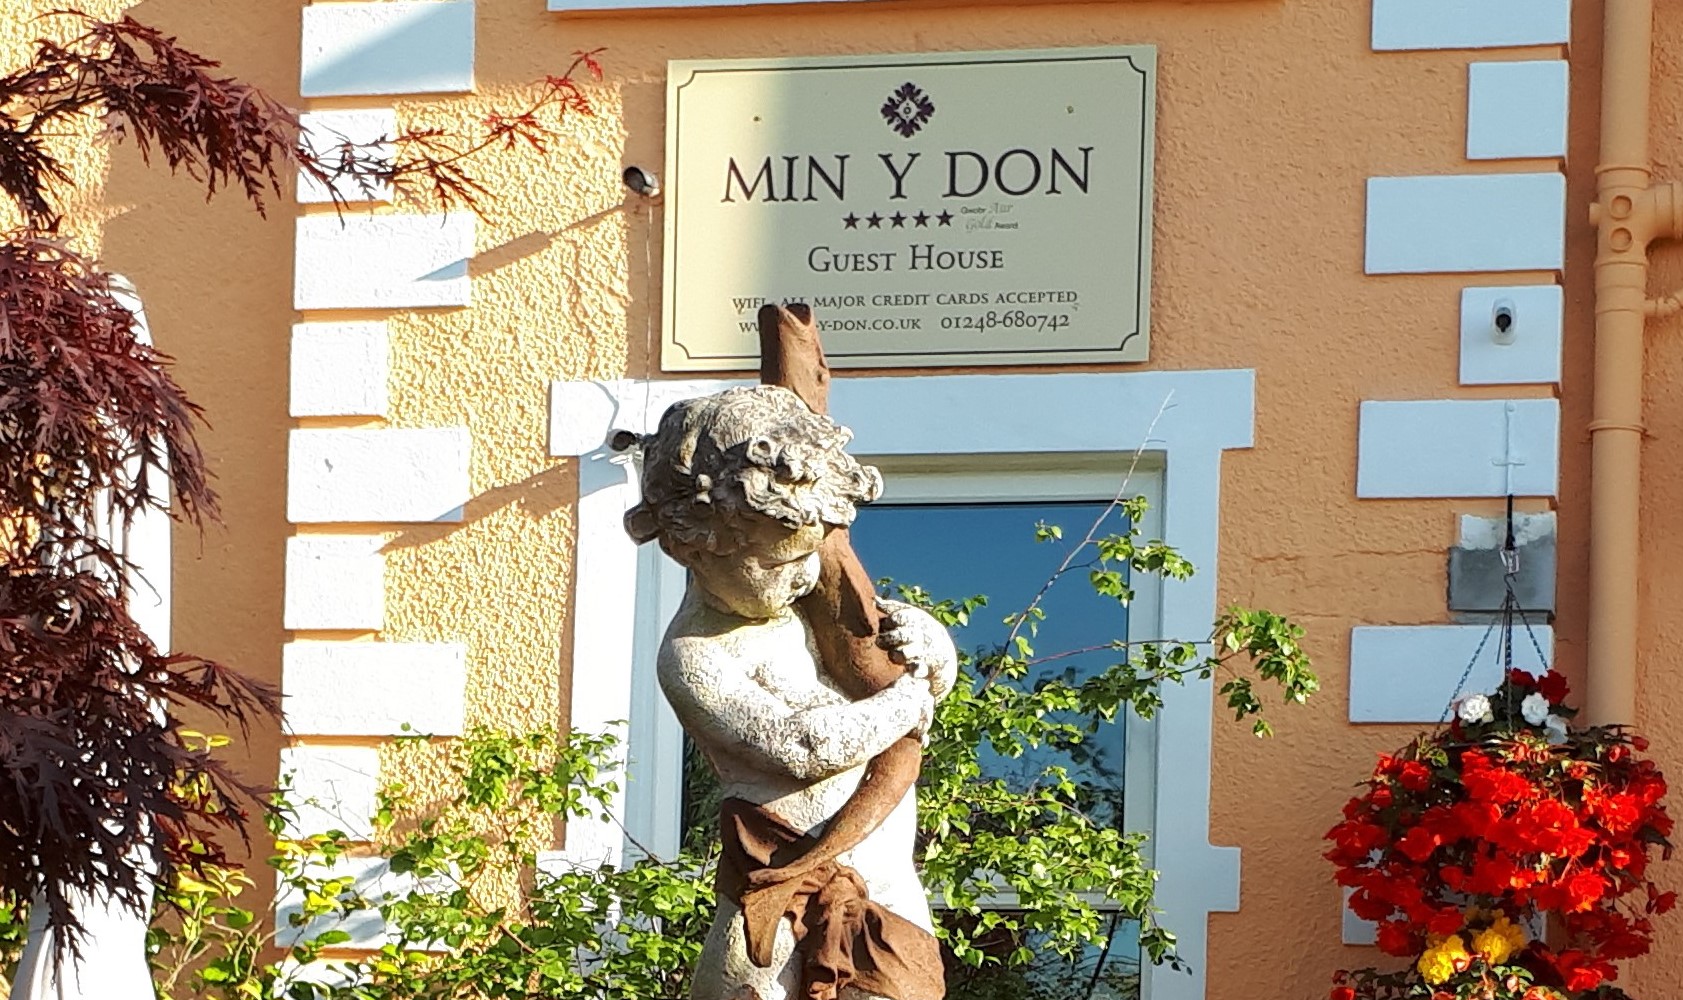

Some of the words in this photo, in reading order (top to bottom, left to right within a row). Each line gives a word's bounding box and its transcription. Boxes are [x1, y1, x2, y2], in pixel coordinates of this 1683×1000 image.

[721, 154, 850, 203] MIN
[878, 151, 921, 201] Y
[942, 146, 1095, 198] DON
[813, 294, 865, 309] MAJOR
[871, 293, 931, 307] CREDIT
[936, 292, 990, 306] CARDS
[995, 290, 1078, 304] ACCEPTED
[940, 310, 1070, 334] 01248-680742
